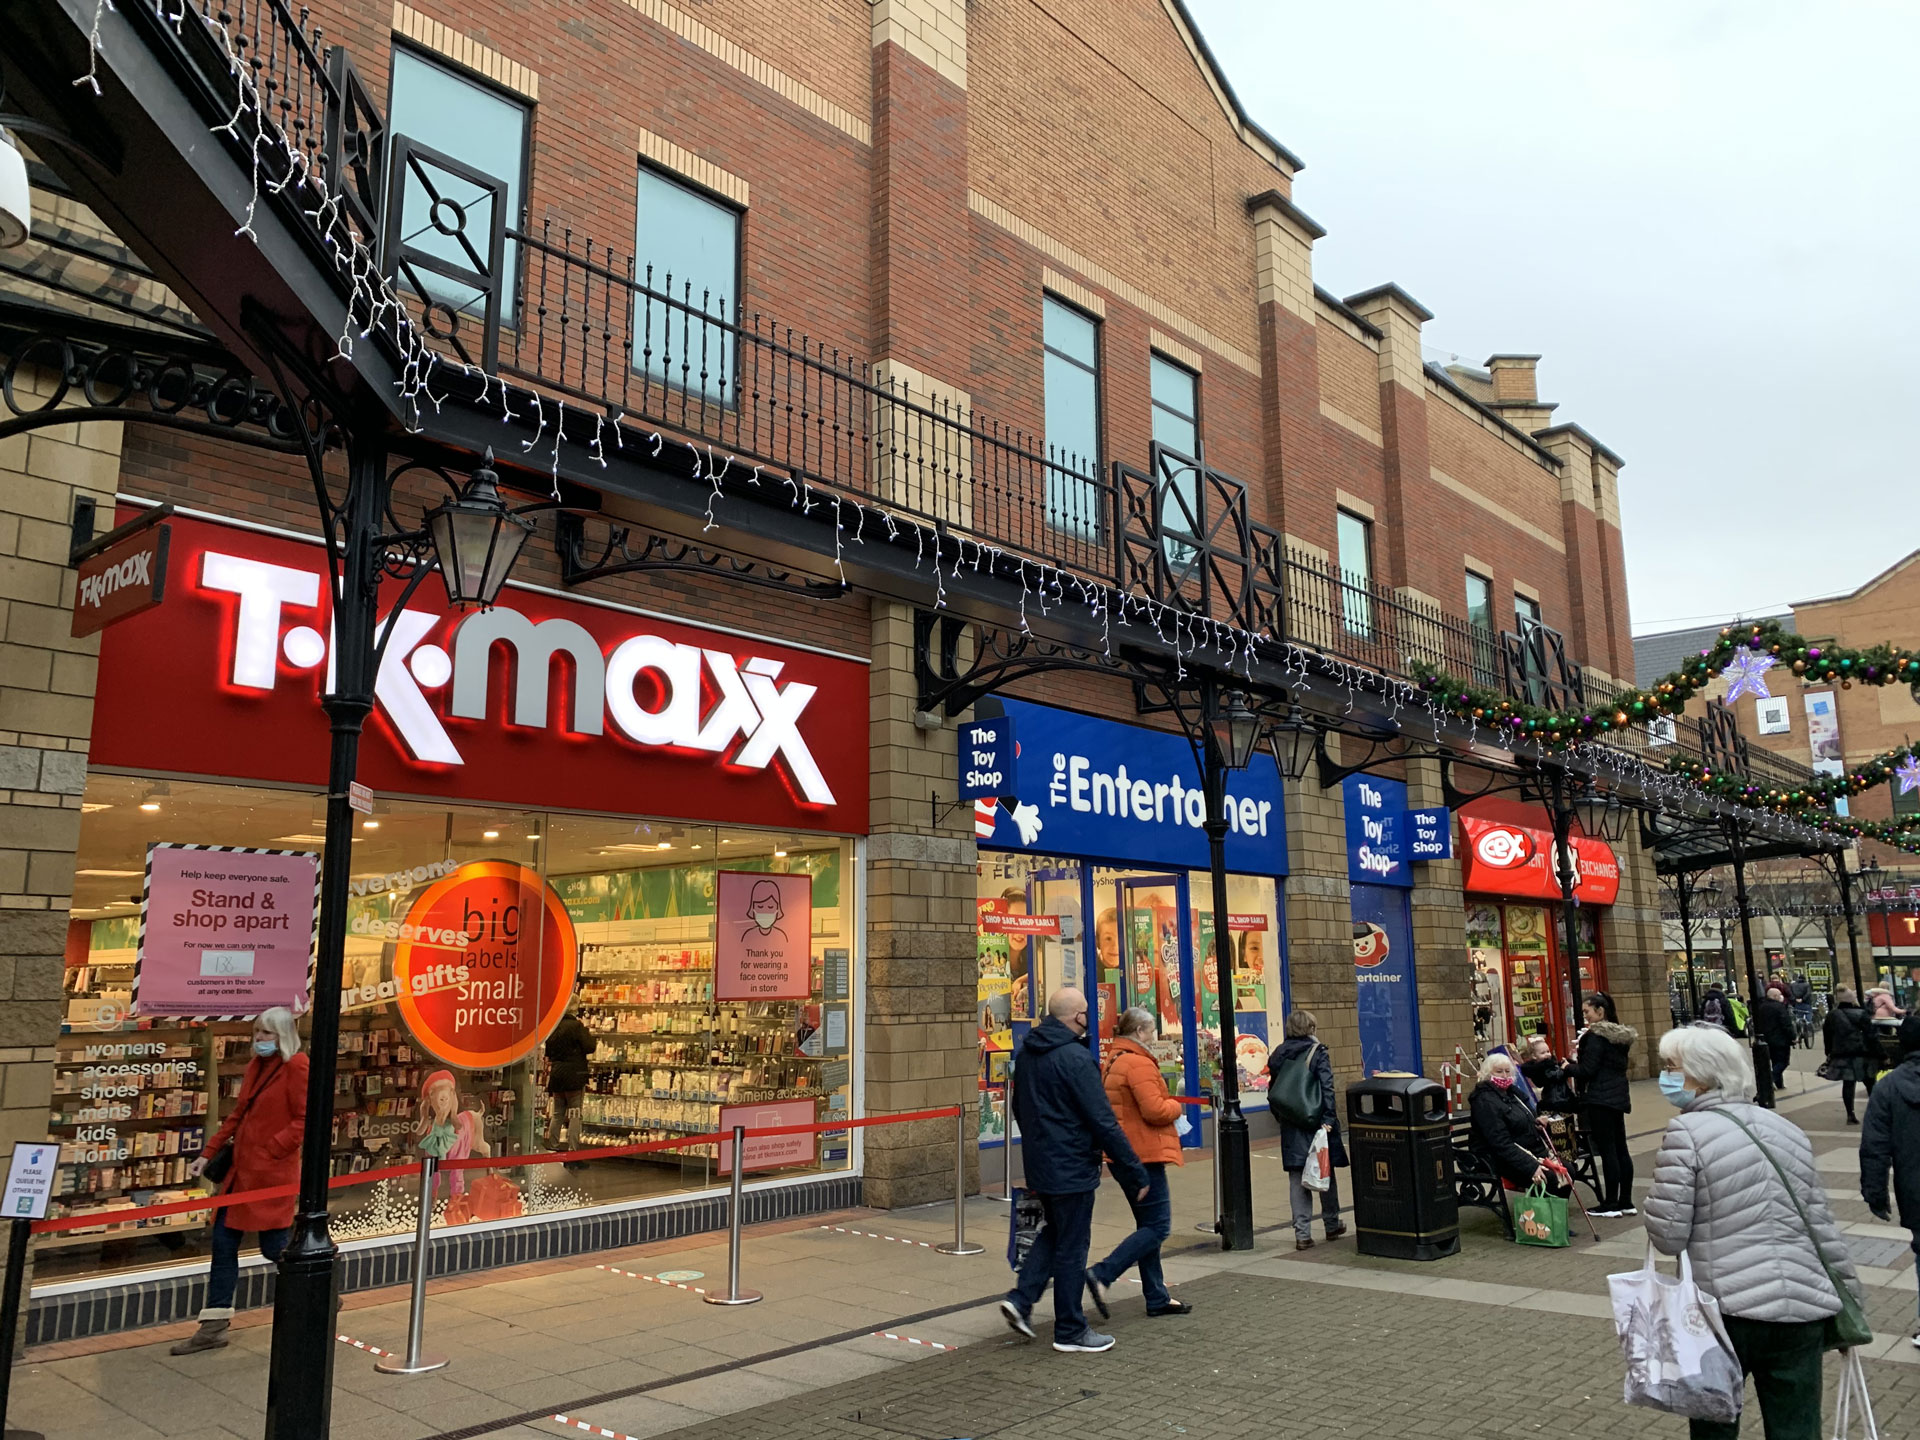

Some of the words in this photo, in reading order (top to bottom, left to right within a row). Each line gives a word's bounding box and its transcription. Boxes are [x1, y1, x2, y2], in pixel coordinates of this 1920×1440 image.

[970, 728, 997, 745] The
[971, 750, 996, 768] Toy
[966, 771, 1002, 788] Shop
[1049, 752, 1067, 808] The
[1069, 755, 1272, 837] Entertaner
[1358, 784, 1382, 808] The
[1414, 814, 1437, 825] The
[1362, 816, 1382, 845] Toy
[1417, 828, 1437, 841] Toy
[1413, 842, 1443, 854] Shop
[1359, 845, 1392, 877] Shop
[1580, 859, 1618, 879] EXCHANGE
[181, 870, 202, 880] Help
[204, 871, 226, 881] keep
[228, 873, 268, 883] everyone
[270, 874, 290, 884] safe.
[349, 858, 460, 899] veryone
[191, 889, 255, 909] Stand
[260, 892, 275, 910] &
[172, 909, 227, 931] shop
[233, 913, 290, 933] apart
[351, 913, 470, 947] deserves
[462, 897, 522, 945] big
[184, 941, 196, 949] For
[241, 942, 256, 951] only
[257, 942, 275, 950] invite
[746, 949, 769, 957] Thank
[770, 950, 784, 959] you
[740, 960, 751, 969] for
[752, 960, 782, 970] wearing
[412, 965, 470, 997] gifts
[740, 972, 756, 981] face
[757, 972, 789, 982] covering
[1356, 972, 1402, 983] ertainer
[207, 988, 220, 997] any
[457, 973, 520, 1001] small
[750, 984, 757, 992] in
[759, 984, 778, 992] store
[1521, 991, 1541, 1001] STUF
[454, 1002, 518, 1033] prices
[85, 1041, 167, 1057] womens
[83, 1059, 197, 1079] accessories
[80, 1083, 139, 1100] shoes
[78, 1104, 132, 1122] mens
[75, 1125, 117, 1143] kids
[348, 1112, 504, 1139] accessoes
[1365, 1131, 1396, 1139] LITTER
[73, 1146, 129, 1164] home
